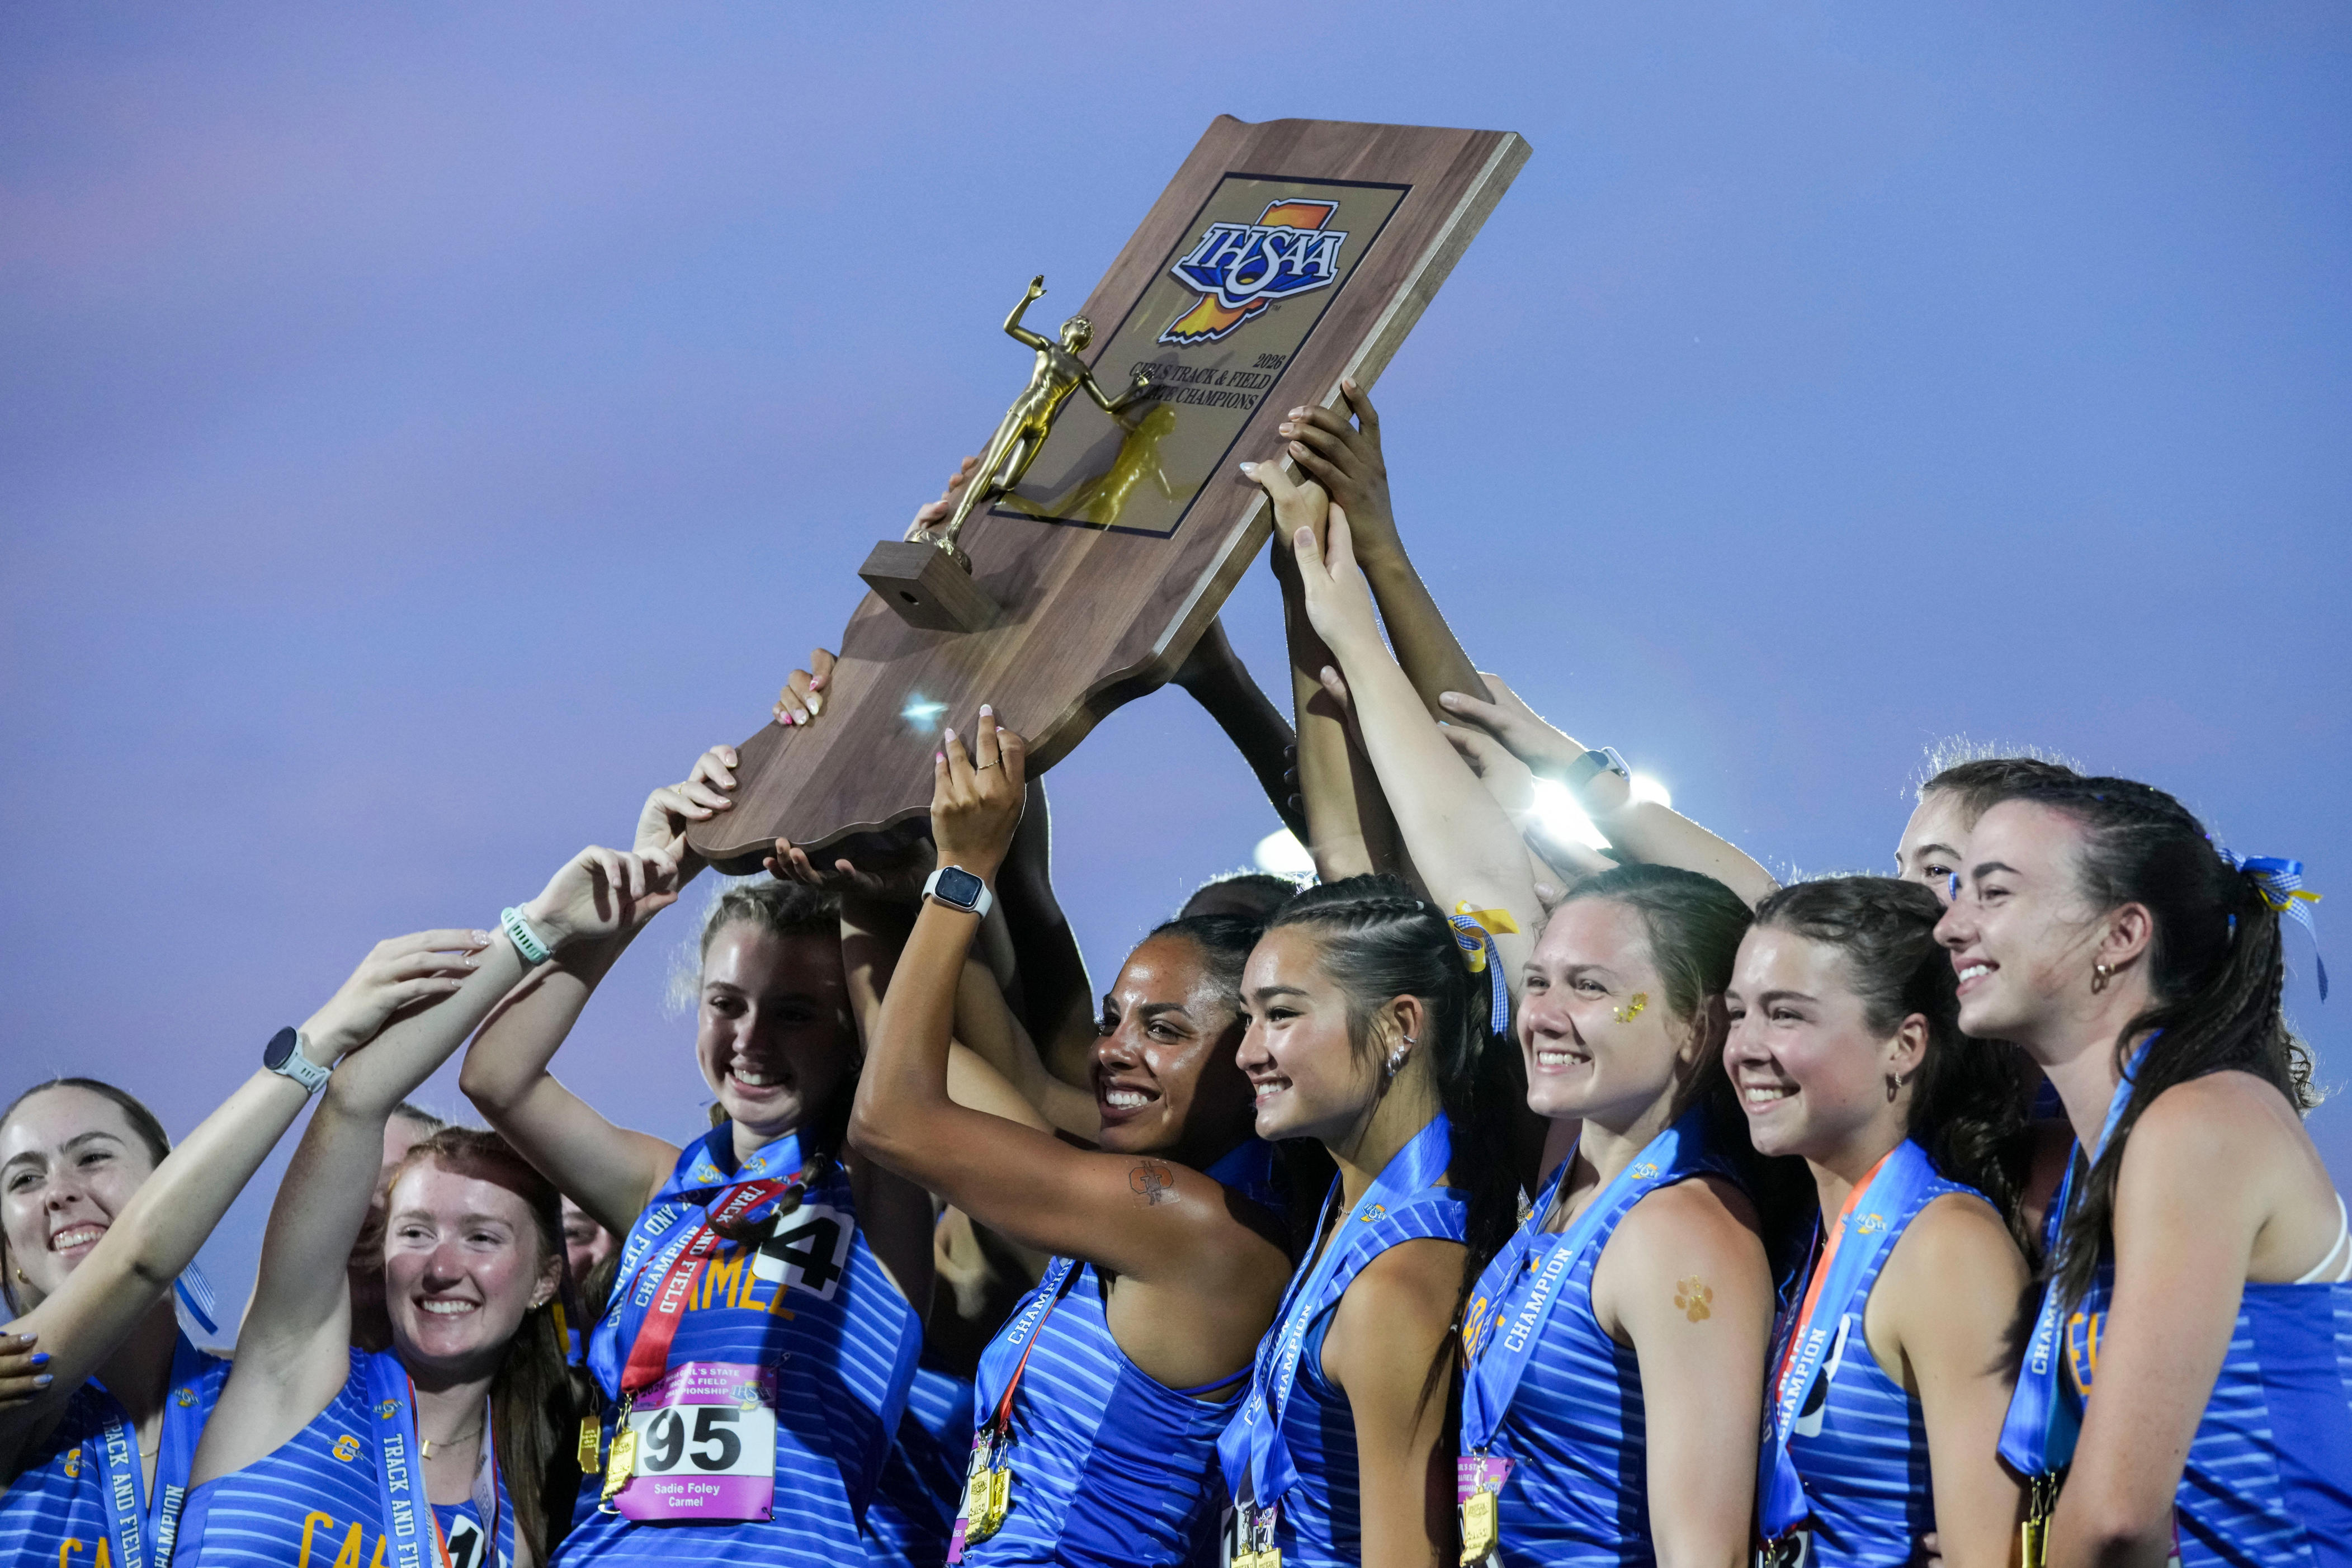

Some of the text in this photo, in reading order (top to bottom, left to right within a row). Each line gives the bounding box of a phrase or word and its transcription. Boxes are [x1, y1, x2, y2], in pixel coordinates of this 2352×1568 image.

[1180, 225, 1340, 295] IHSAA
[1169, 366, 1220, 385] TRACK
[1214, 374, 1228, 386] &
[1225, 371, 1272, 390] FIELD
[1253, 353, 1286, 370] 2026
[1175, 387, 1259, 410] CHAMPIONS
[643, 1203, 678, 1236] AND
[759, 1216, 842, 1292] 4
[659, 1260, 698, 1314] FIELD
[1504, 1247, 1573, 1352] CHAMPION
[1277, 1304, 1312, 1414] CHAMPION
[1778, 1328, 1827, 1442] CHAMPION
[102, 1415, 129, 1468] TRACK
[384, 1433, 409, 1494] TRACK
[643, 1408, 742, 1472] 95
[112, 1473, 135, 1512] AND
[654, 1483, 720, 1496] Sadie Foley
[668, 1496, 703, 1507] Carmel
[391, 1499, 415, 1537] AND
